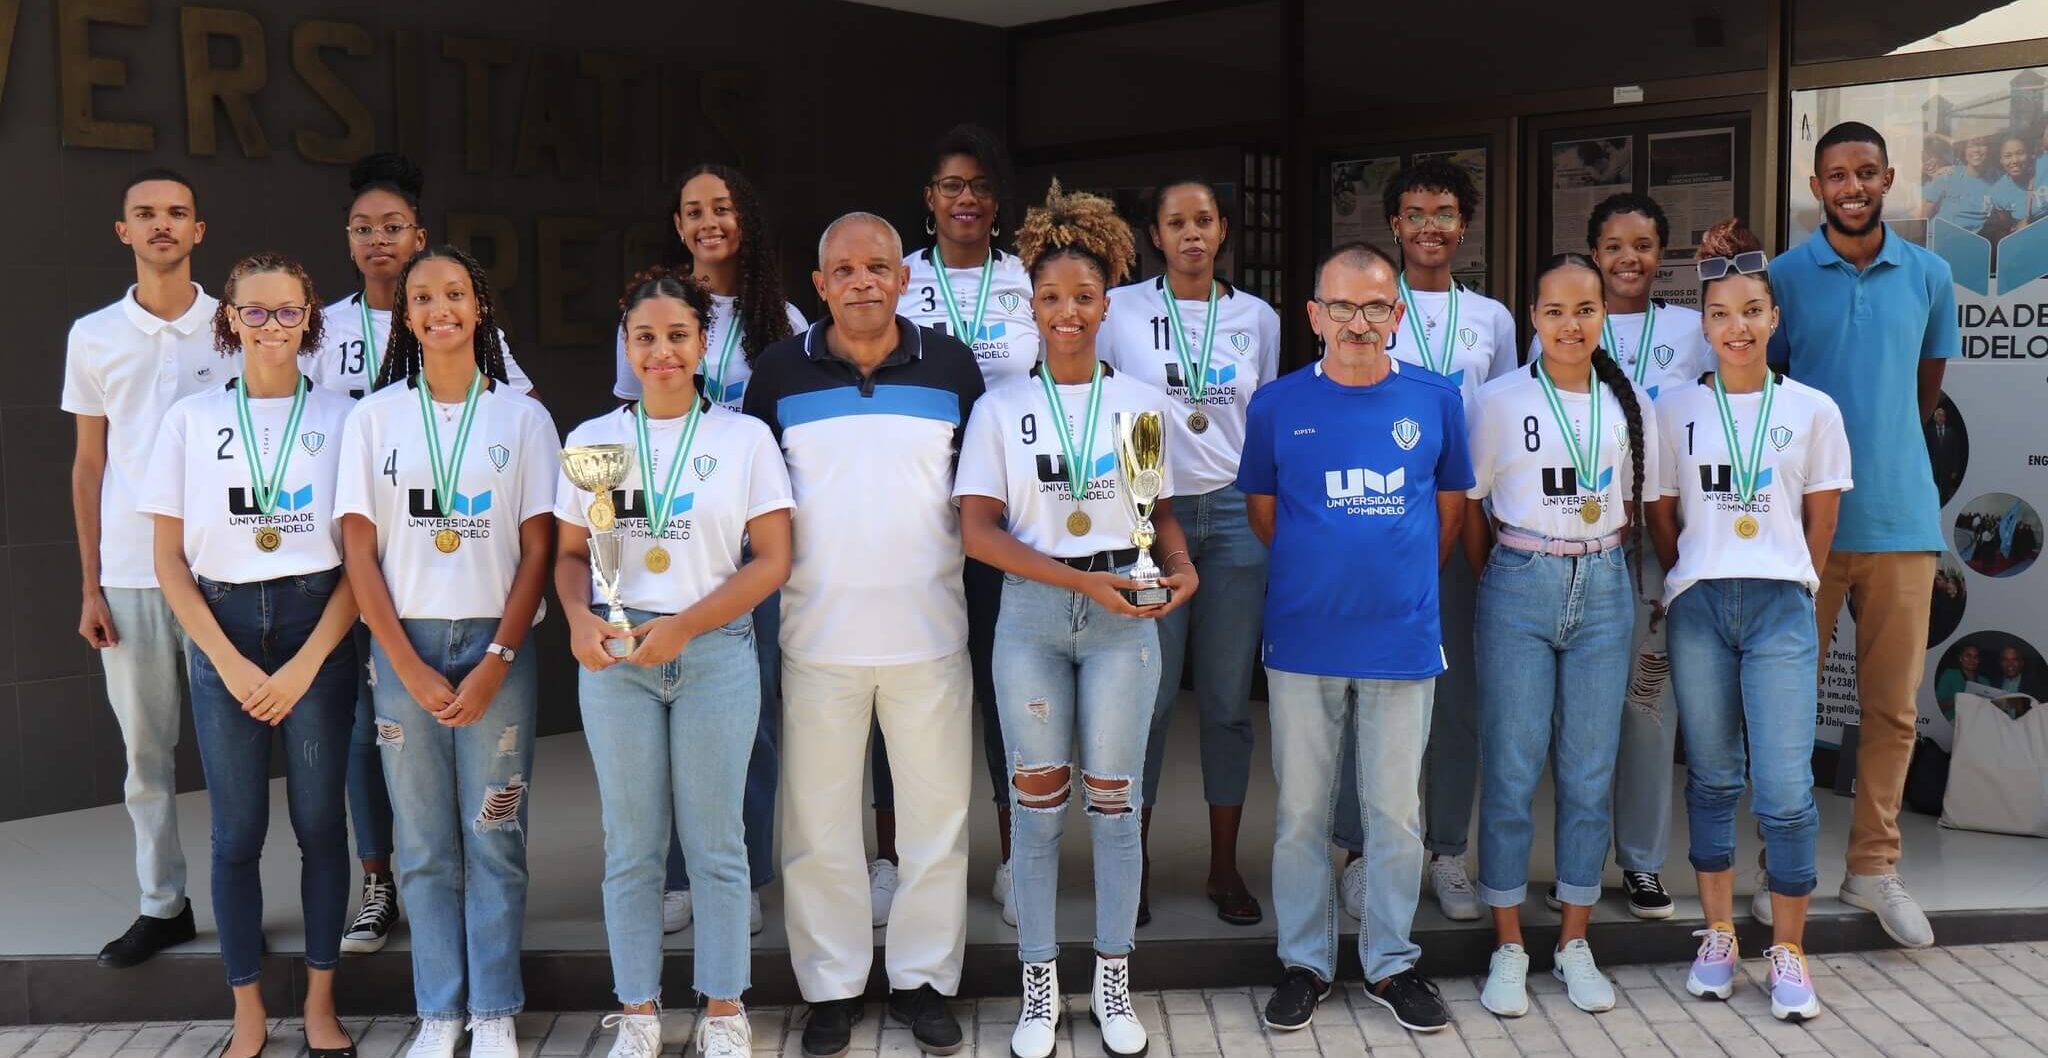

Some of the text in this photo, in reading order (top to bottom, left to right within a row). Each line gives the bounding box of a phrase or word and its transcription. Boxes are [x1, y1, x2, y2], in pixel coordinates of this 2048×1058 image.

[921, 286, 936, 312] 3
[1653, 288, 1698, 297] CURSOS DE
[1665, 297, 1698, 305] STRADO
[1957, 303, 2048, 328] IDADE
[1150, 316, 1170, 351] 11
[971, 342, 1009, 352] SIDADE
[338, 340, 366, 376] 13
[1021, 413, 1037, 446] 9
[1294, 428, 1316, 436] KIPSTA
[1523, 415, 1541, 453] 8
[217, 427, 235, 460] 2
[1685, 421, 1695, 456] 1
[2028, 454, 2048, 466] ENG
[383, 448, 398, 487] 4
[1326, 495, 1405, 508] UNIVERSIDADE
[1727, 503, 1771, 513] MINDELO
[1347, 506, 1405, 515] DO MINDELO
[408, 518, 492, 528] UNIVERSIDADE
[1828, 675, 1856, 690] (+238)
[1827, 690, 1858, 703] um.edu.
